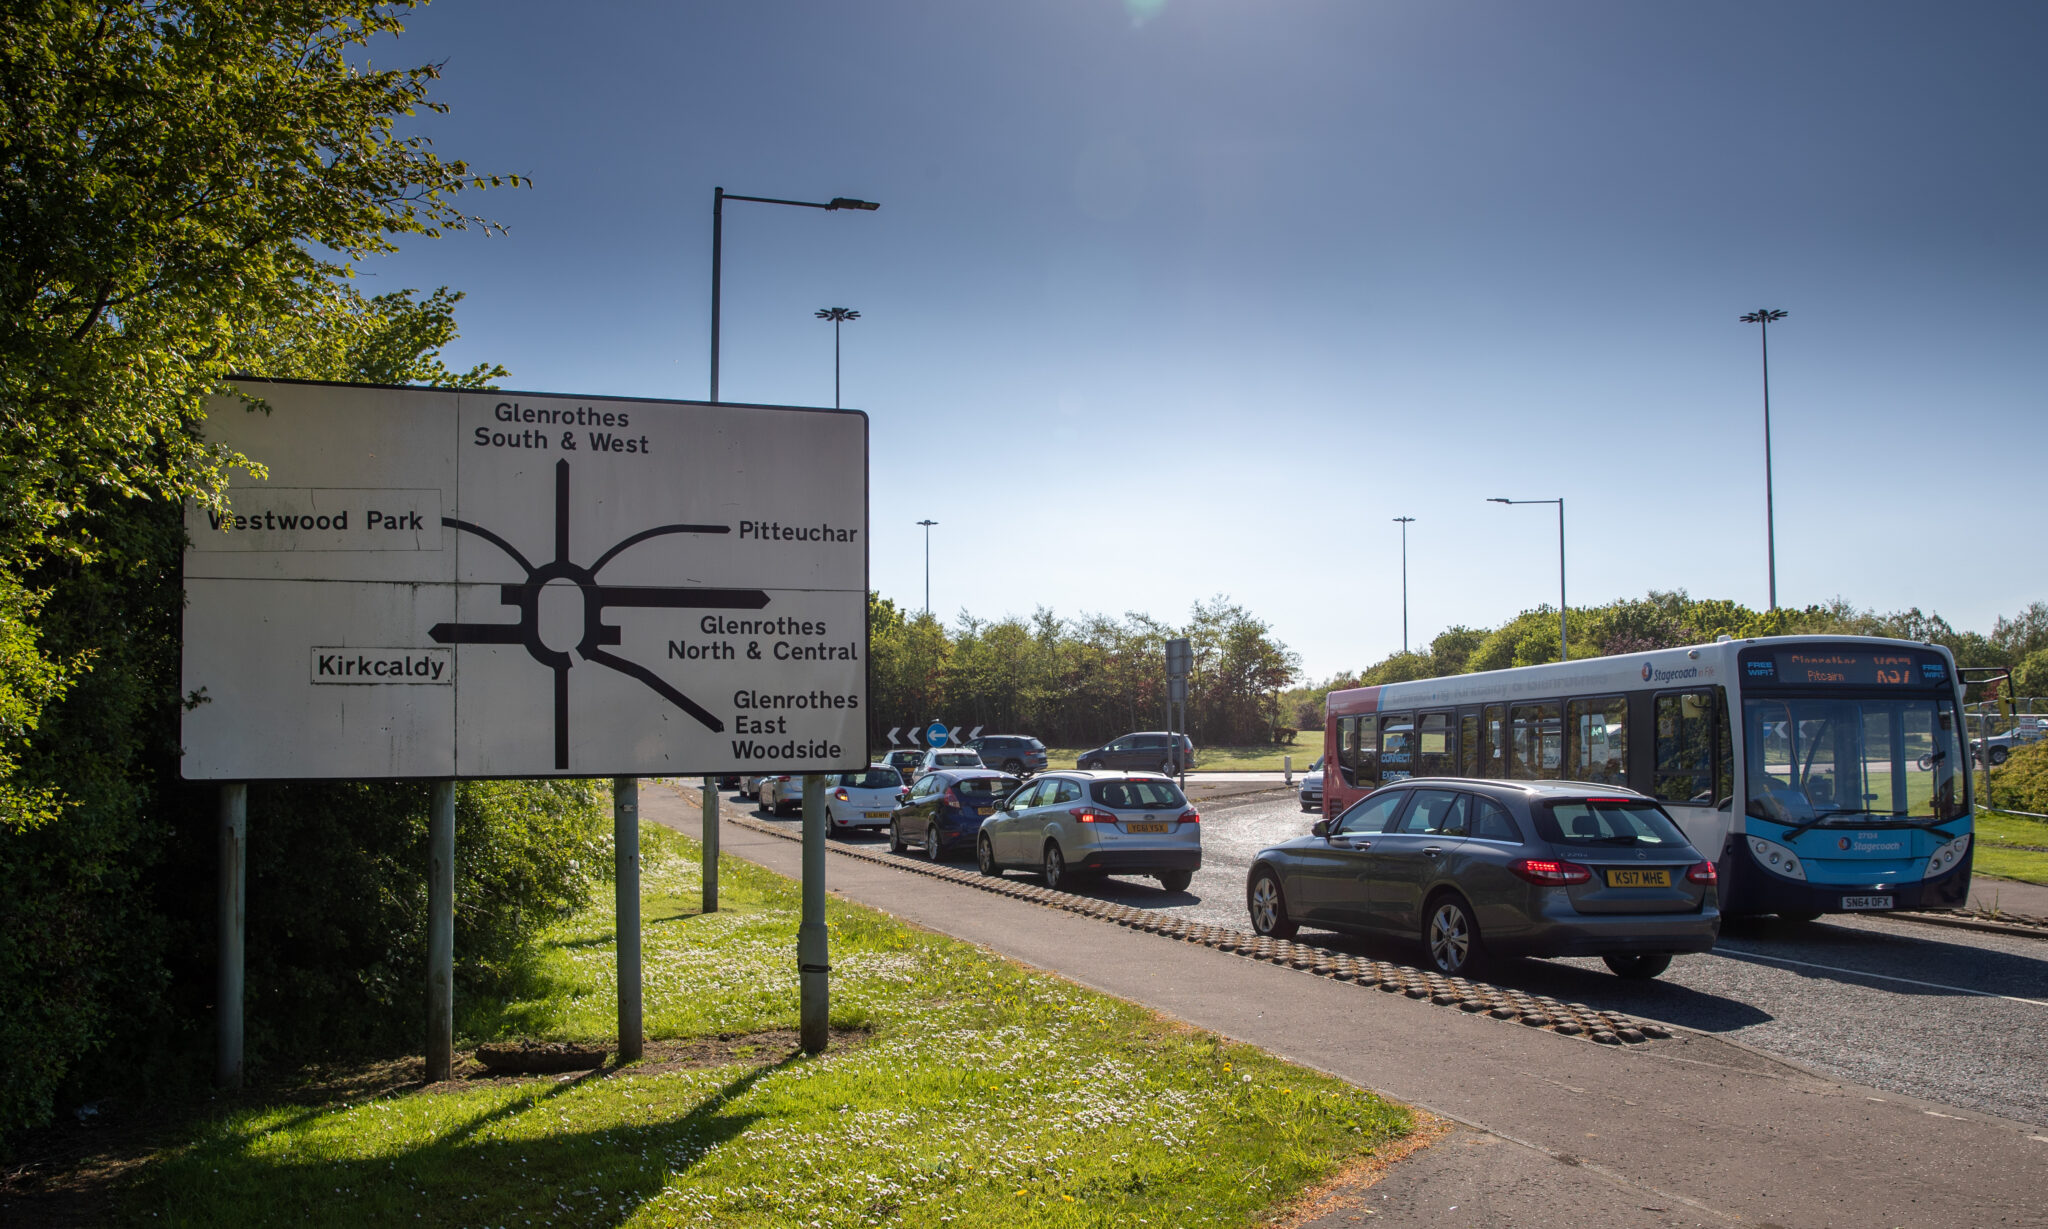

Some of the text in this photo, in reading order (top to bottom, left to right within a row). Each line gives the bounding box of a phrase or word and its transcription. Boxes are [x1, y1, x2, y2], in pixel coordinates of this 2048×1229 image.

[495, 402, 629, 427] Glenrothes
[474, 427, 649, 454] South & West
[367, 510, 424, 530] Park
[740, 520, 858, 542] Pitteuchar
[700, 615, 826, 635] Glenrothes
[668, 640, 858, 660] North & Central
[319, 655, 444, 680] Kirkcaldy
[1747, 661, 1772, 669] FREE
[1654, 667, 1697, 684] Stagecoach
[1807, 670, 1845, 682] Pitcairn
[733, 690, 858, 709] Glenrothes
[735, 715, 787, 734] East
[731, 740, 841, 759] Woodside
[1853, 841, 1900, 852] Stagecoach
[1614, 872, 1664, 885] KS17 MHE
[1846, 898, 1869, 907] SN64
